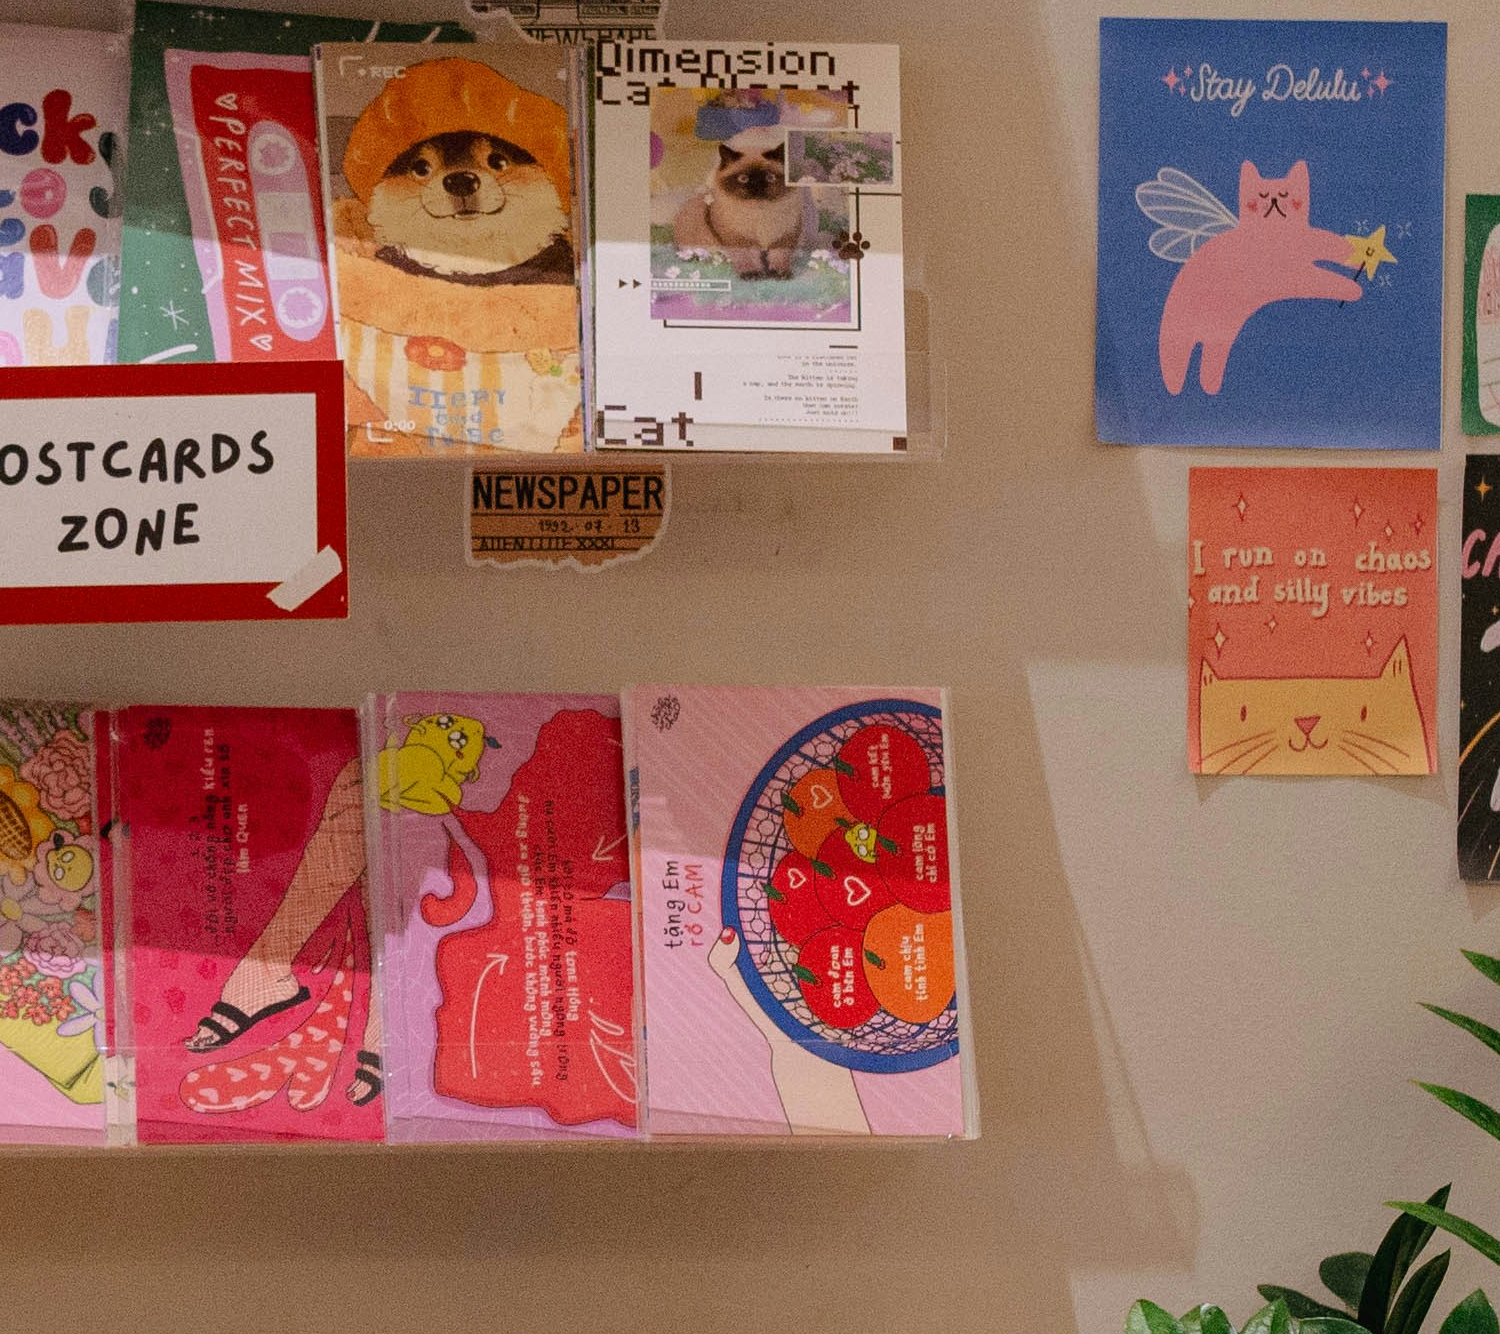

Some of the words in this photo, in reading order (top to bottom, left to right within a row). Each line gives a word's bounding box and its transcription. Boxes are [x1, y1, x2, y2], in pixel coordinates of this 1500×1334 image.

[597, 41, 836, 77] Dimension
[1188, 61, 1257, 119] Stay
[1263, 64, 1363, 103] Delulu
[208, 116, 258, 252] PERFECT
[233, 259, 269, 327] MIX
[597, 404, 695, 447] Cat
[472, 474, 664, 511] NEWSPAPER
[56, 500, 203, 556] ZONE
[1192, 538, 1206, 580] I
[1221, 544, 1277, 572] run
[1293, 543, 1329, 572] on
[1353, 539, 1434, 574] chaos
[1207, 575, 1263, 608] and
[1272, 575, 1332, 620] silly
[1340, 575, 1411, 609] vibes
[661, 858, 682, 893] Em
[683, 863, 705, 916] CAM
[662, 895, 687, 951] tặng
